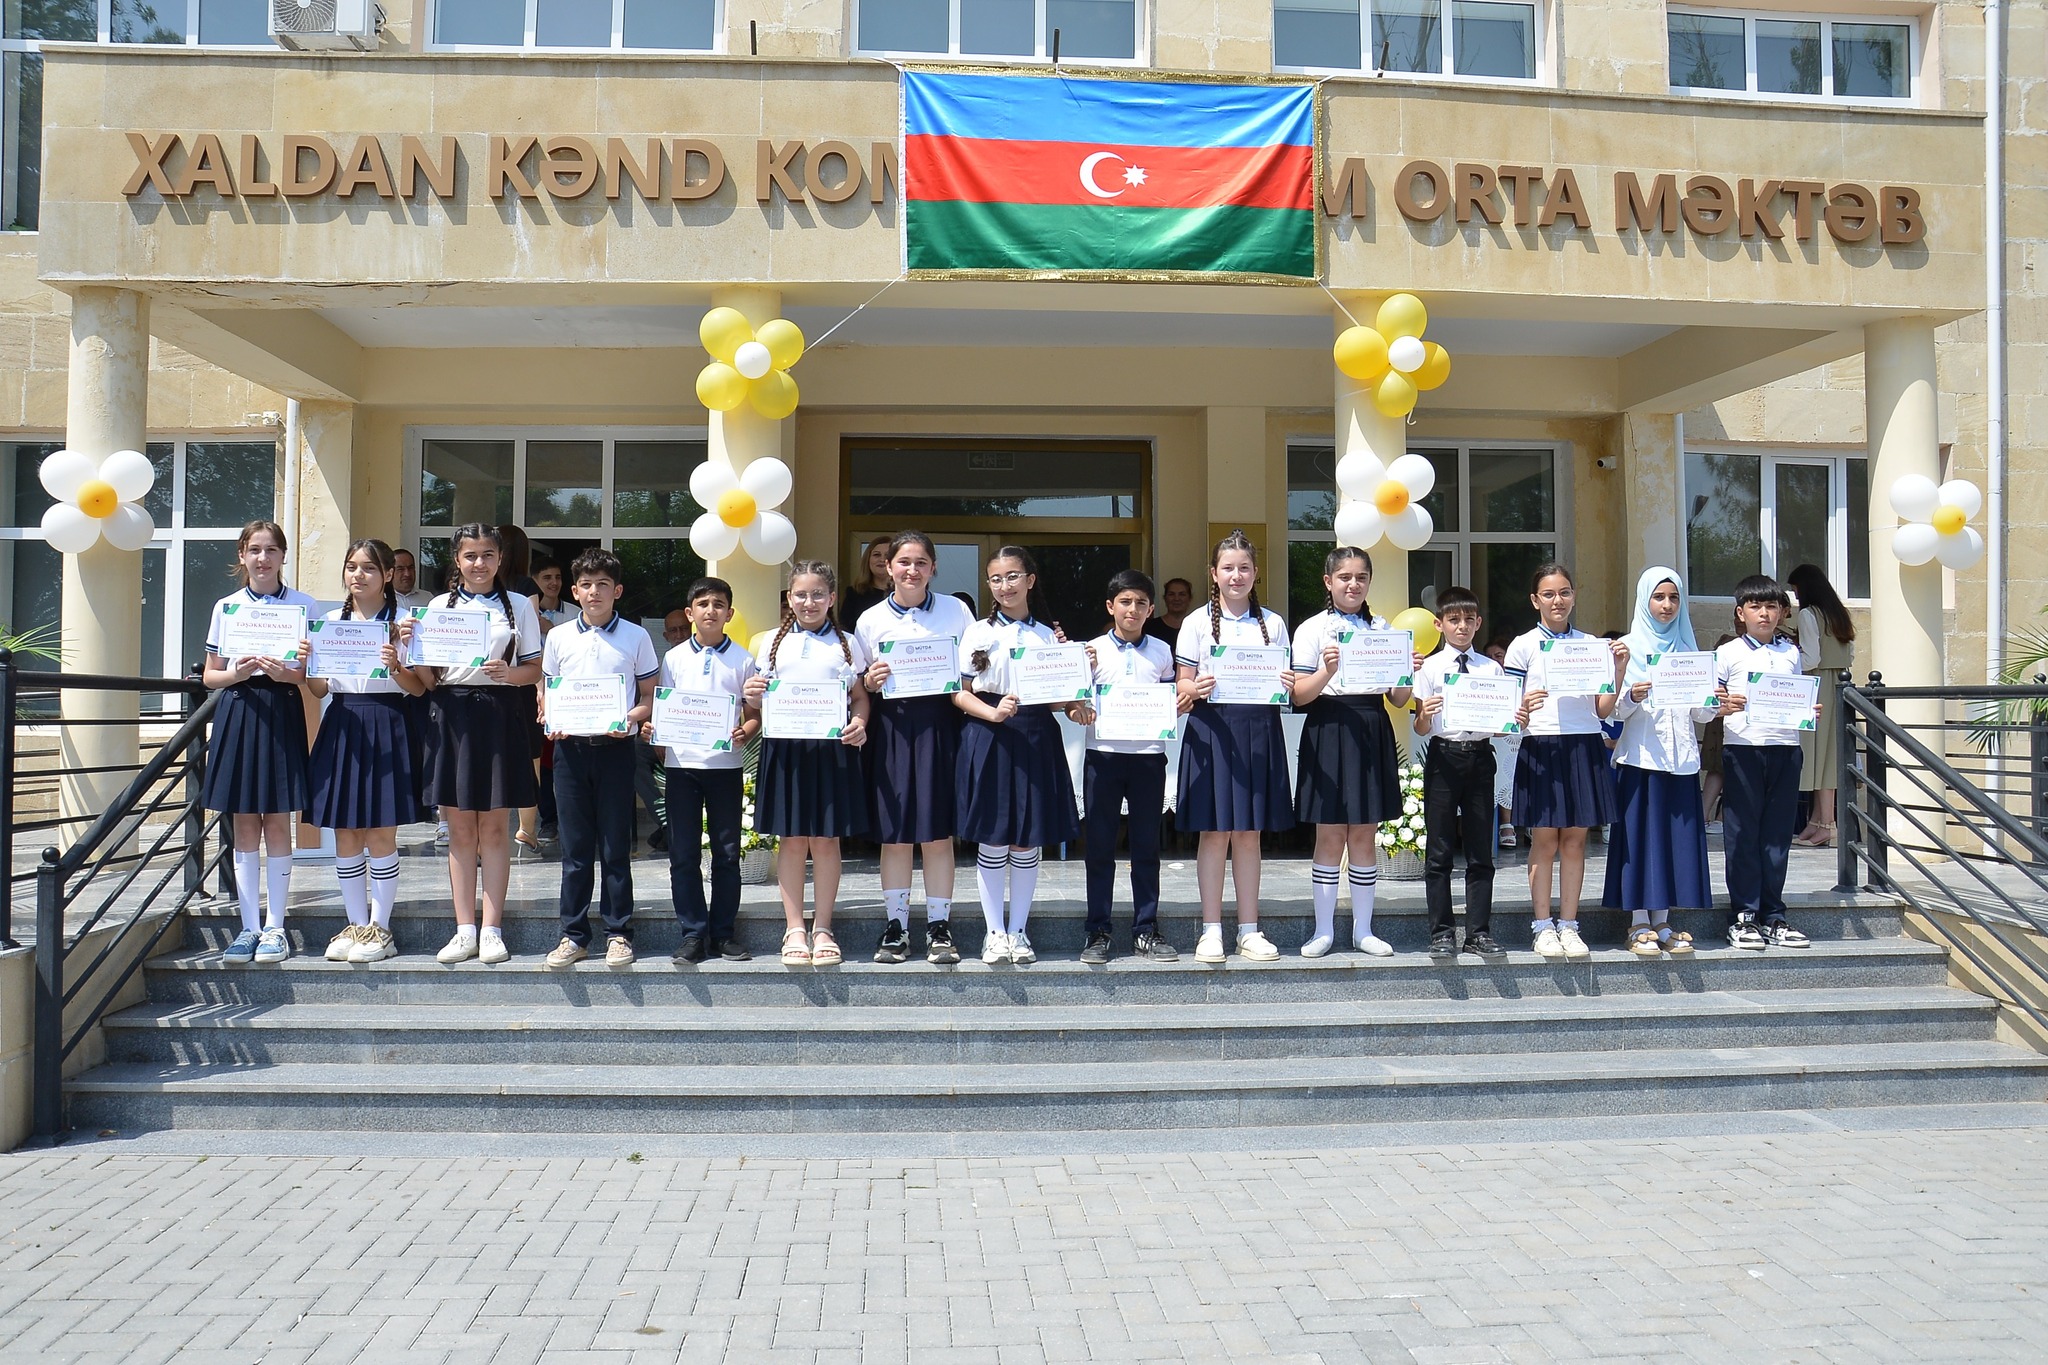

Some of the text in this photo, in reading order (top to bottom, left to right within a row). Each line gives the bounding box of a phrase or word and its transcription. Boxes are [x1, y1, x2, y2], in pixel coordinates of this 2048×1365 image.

[122, 131, 456, 198] XALDAN
[488, 135, 725, 202] KƏND
[1393, 159, 1591, 228] ORTA
[1615, 171, 1927, 246] MƏKTƏB
